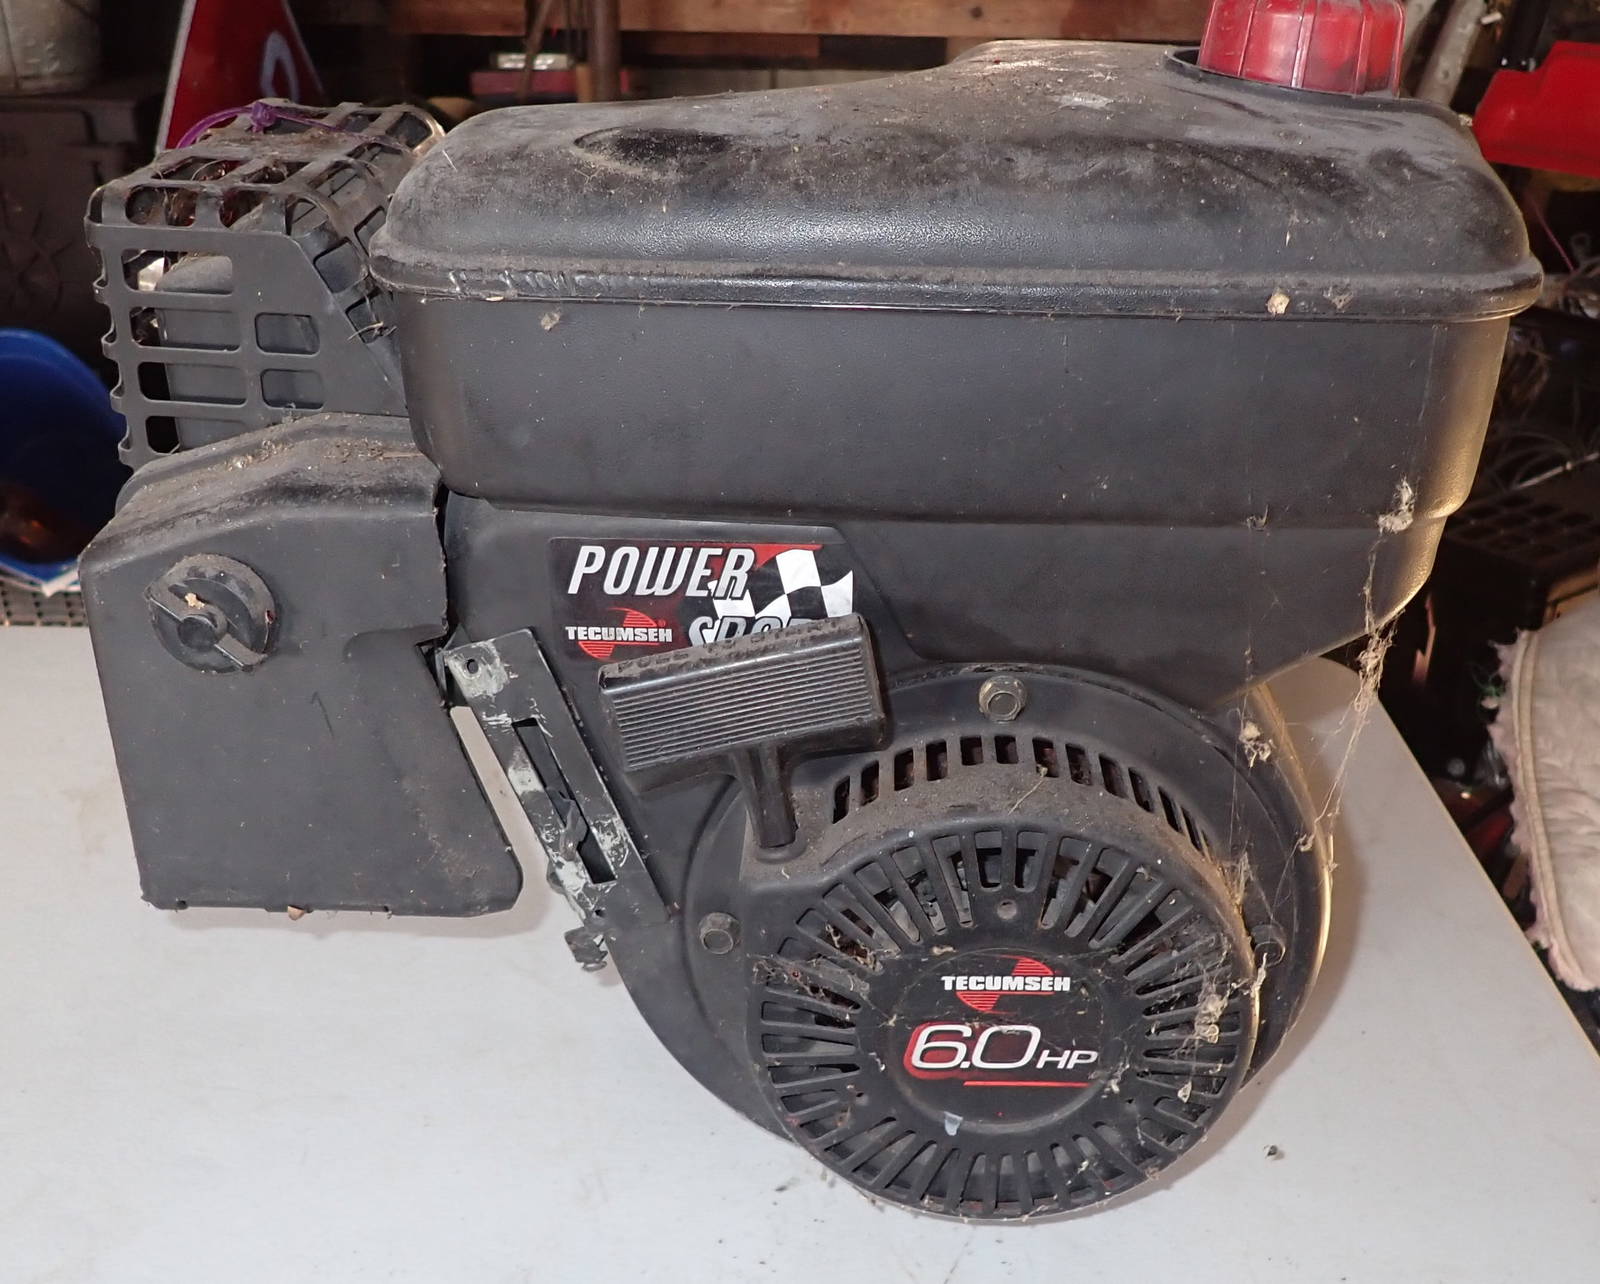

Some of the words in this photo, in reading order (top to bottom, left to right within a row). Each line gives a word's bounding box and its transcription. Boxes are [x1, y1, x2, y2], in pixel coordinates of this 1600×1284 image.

[567, 545, 755, 597] POWER
[565, 626, 673, 643] TECUMSEH
[941, 976, 1071, 992] TECUMSEH
[911, 1024, 1042, 1069] 6.0
[1036, 1050, 1099, 1069] HP
